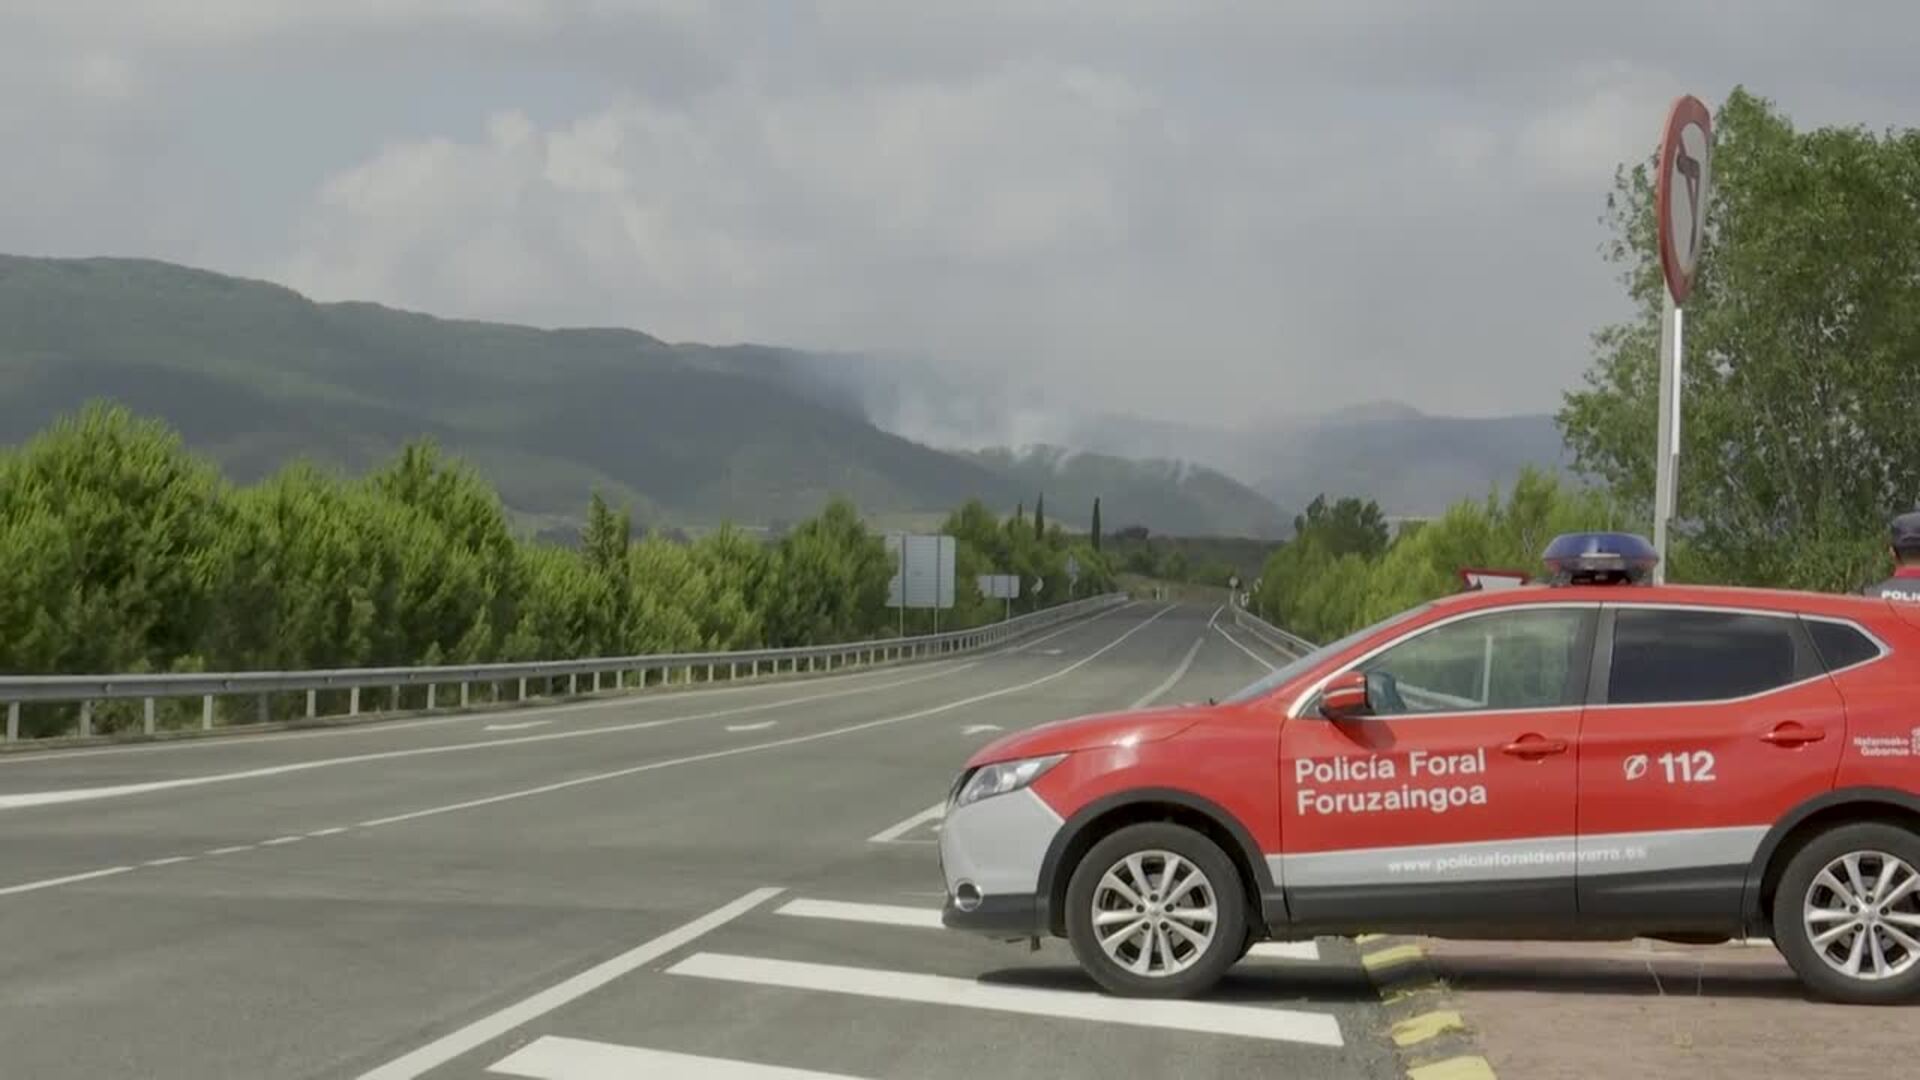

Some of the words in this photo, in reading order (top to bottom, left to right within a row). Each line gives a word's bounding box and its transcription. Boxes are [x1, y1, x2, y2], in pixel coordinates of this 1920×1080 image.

[1295, 754, 1396, 783] Policía
[1410, 747, 1487, 777] Foral
[1658, 750, 1717, 783] 112
[1297, 784, 1488, 815] Foruzaingoa
